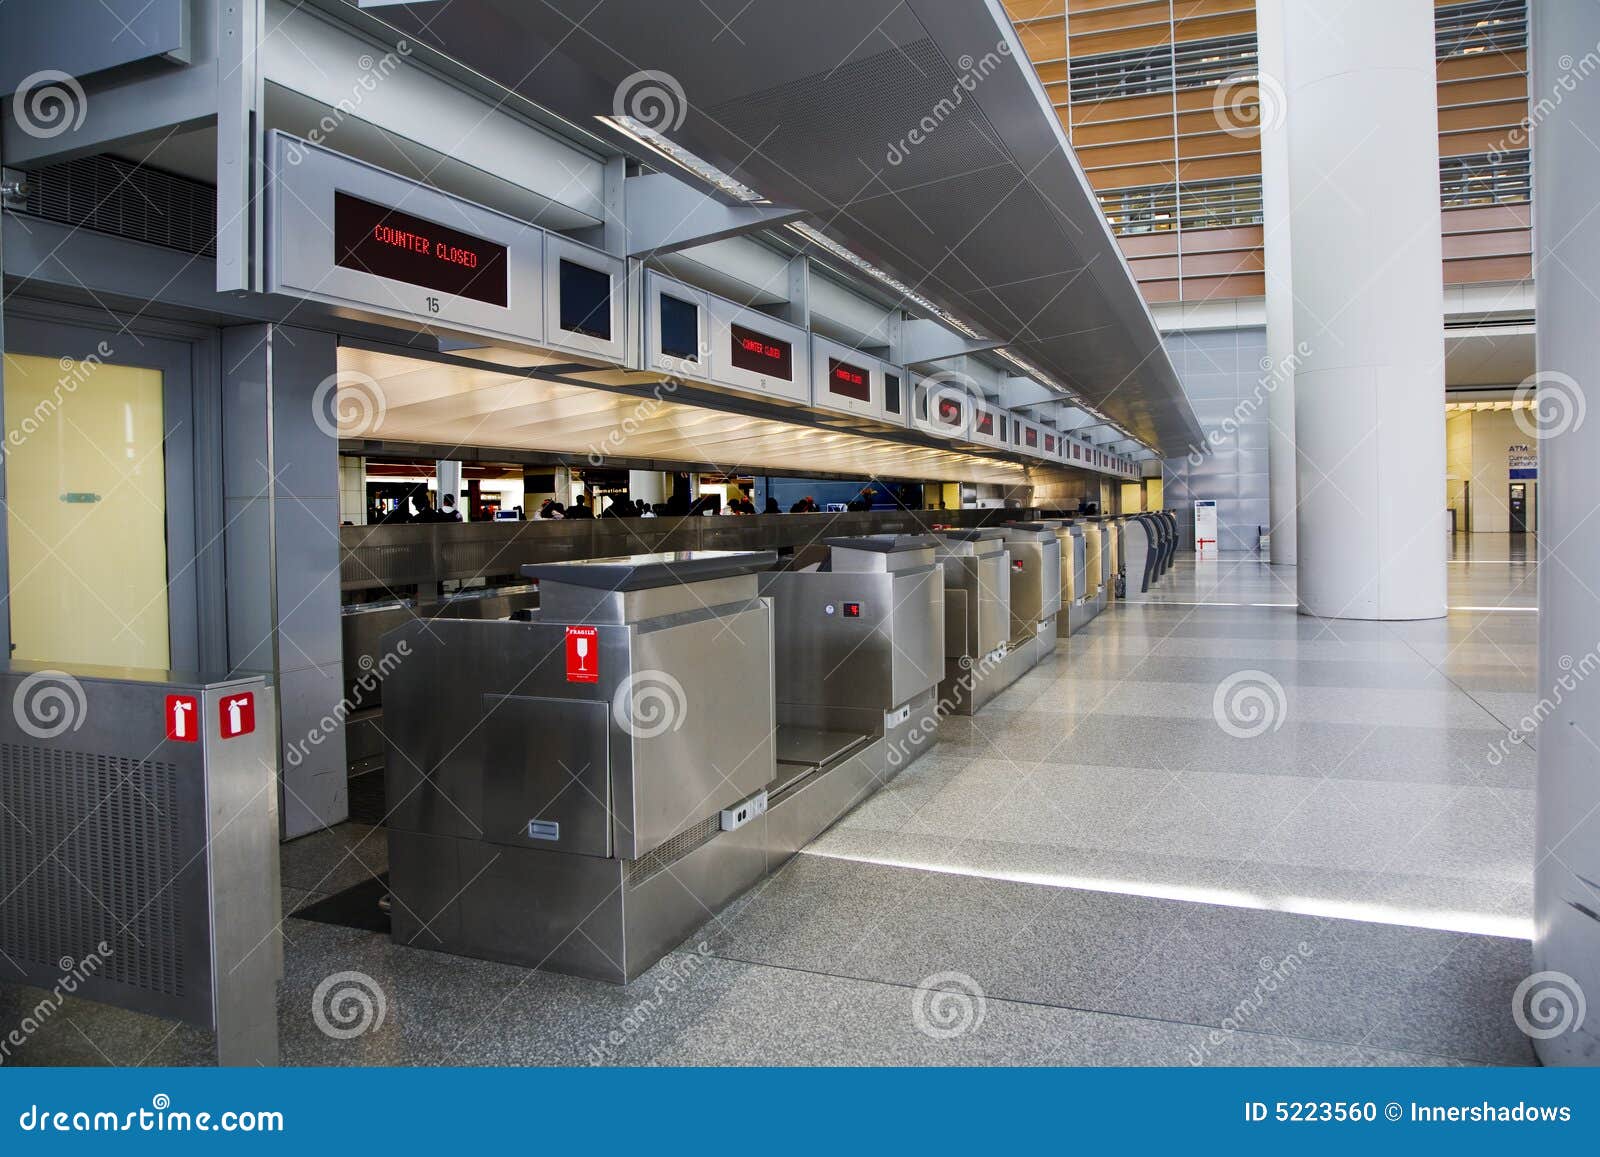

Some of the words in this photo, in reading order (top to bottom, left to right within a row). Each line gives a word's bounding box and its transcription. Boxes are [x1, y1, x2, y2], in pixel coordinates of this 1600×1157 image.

[374, 224, 430, 255] COUNTER
[436, 242, 477, 268] CLOSED
[426, 296, 440, 313] 15
